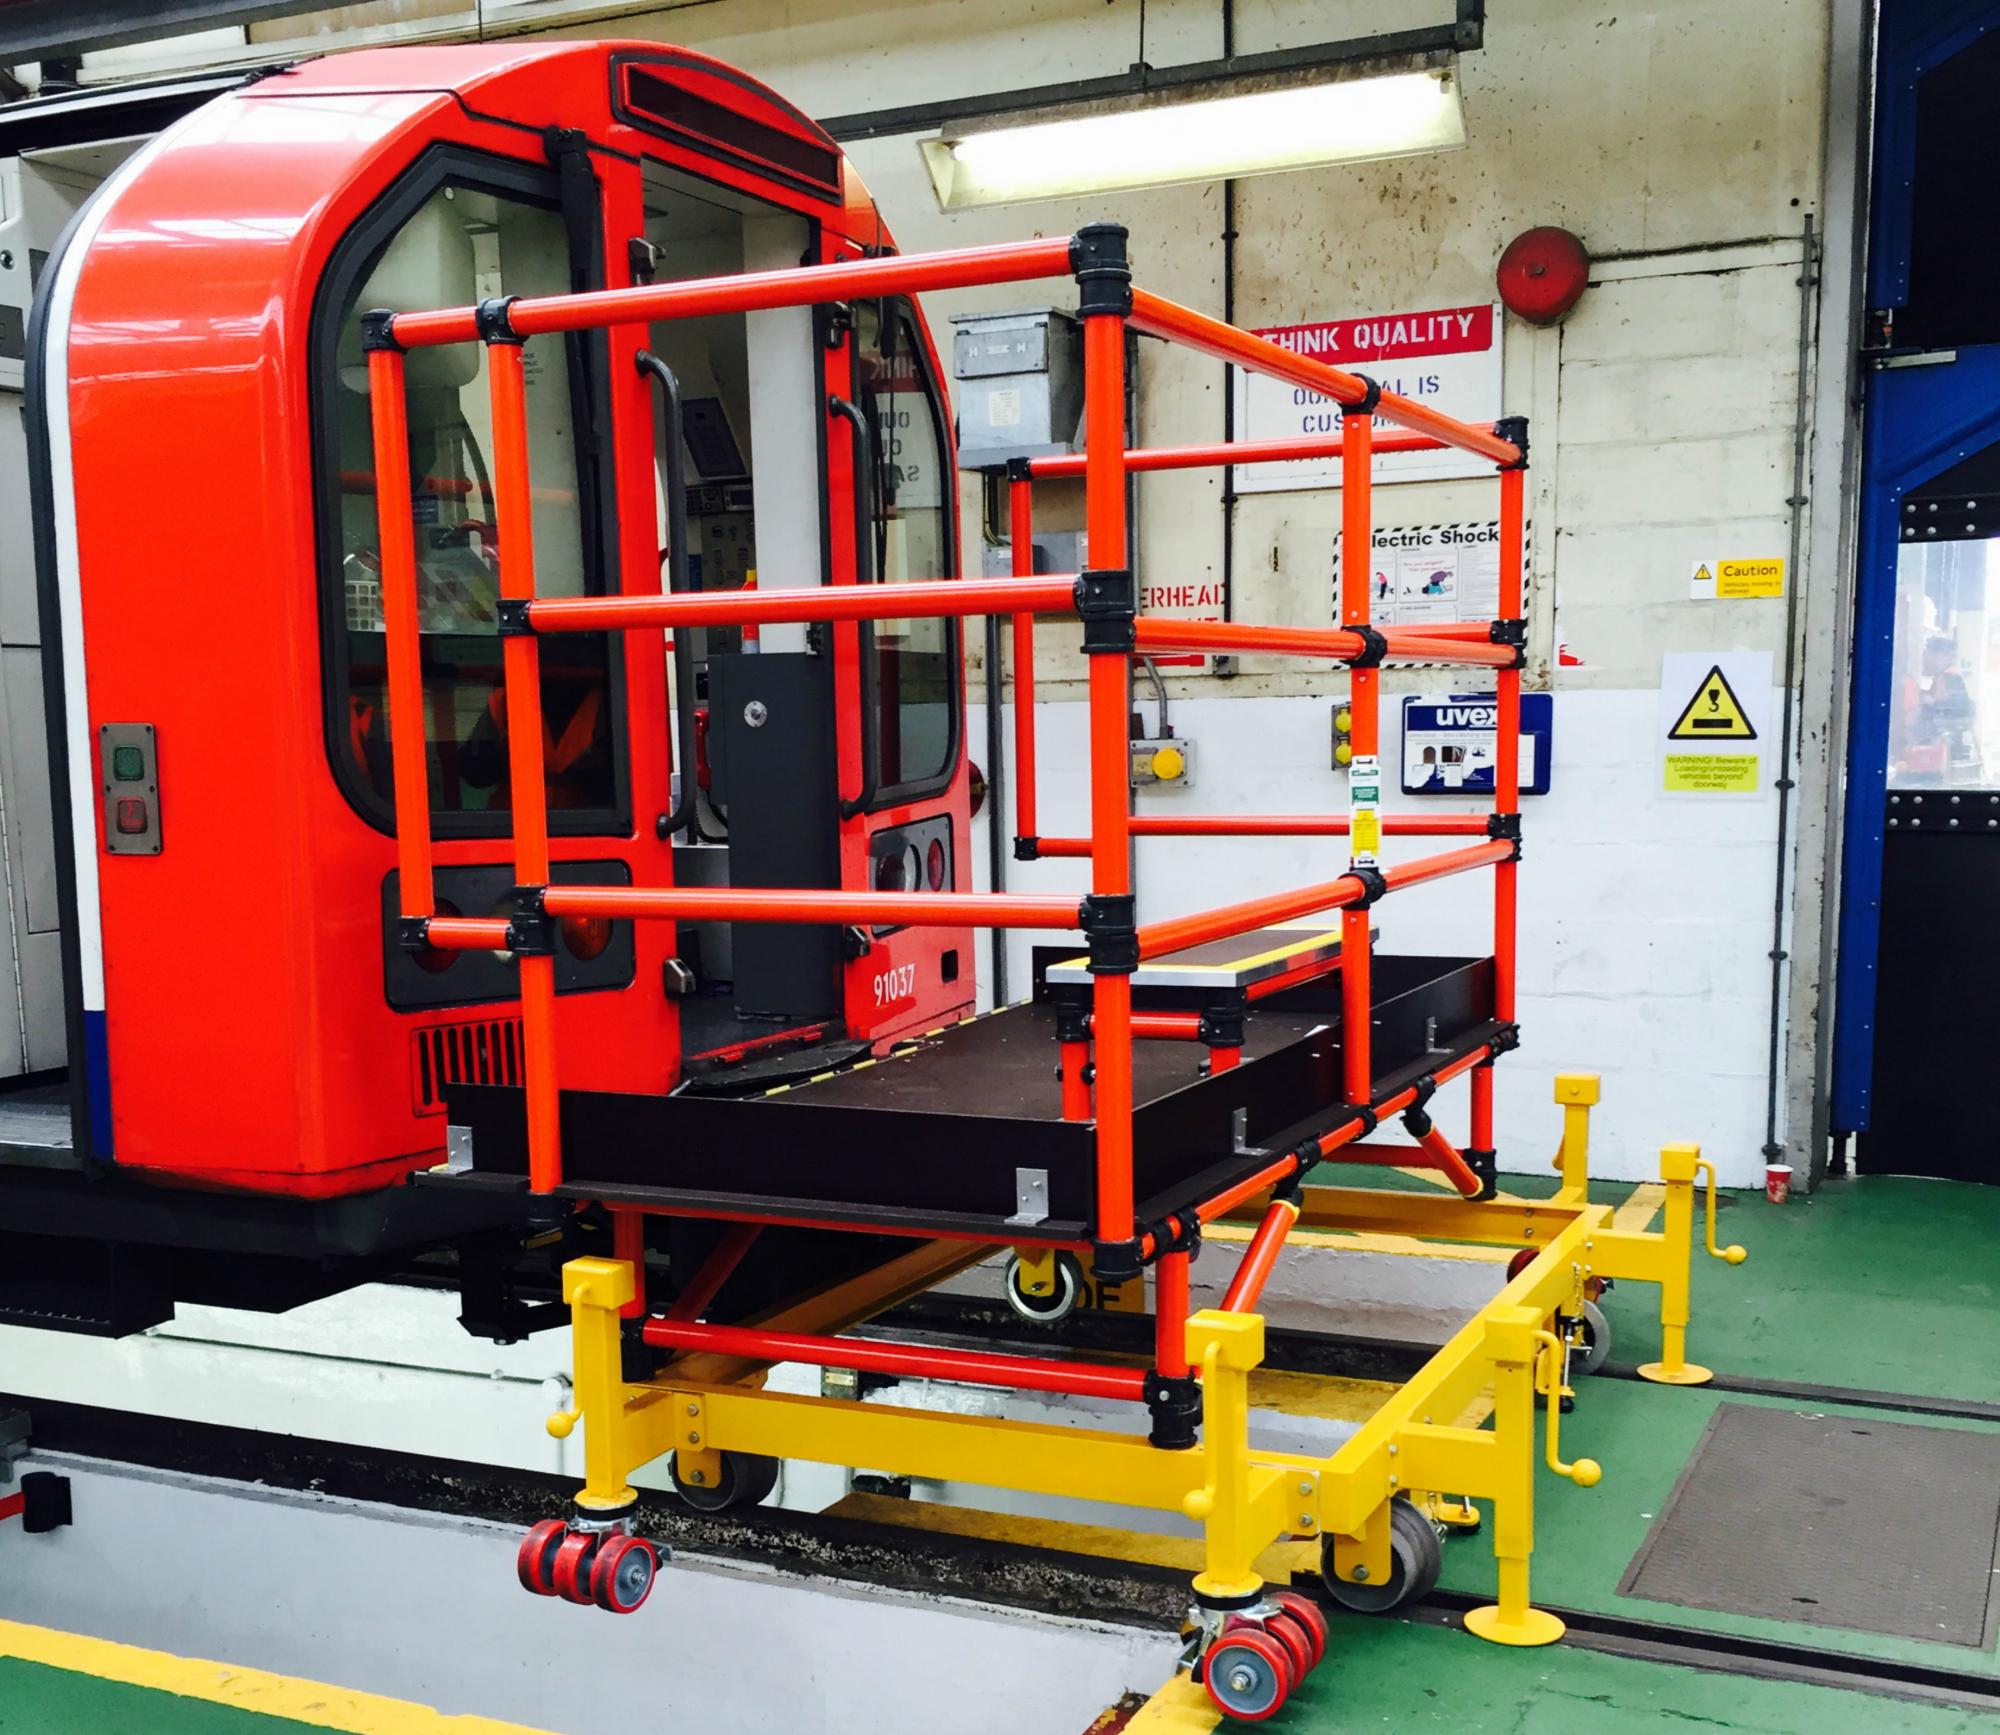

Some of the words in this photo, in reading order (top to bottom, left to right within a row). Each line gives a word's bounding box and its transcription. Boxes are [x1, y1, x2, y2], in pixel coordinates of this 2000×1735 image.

[1353, 313, 1474, 349] QUALITY
[1419, 375, 1439, 394] IS
[1372, 532, 1432, 548] lectric
[1440, 528, 1499, 544] Shock
[1723, 565, 1777, 577] Caution
[1140, 583, 1226, 608] ERHEAD
[874, 963, 915, 1007] 91037
